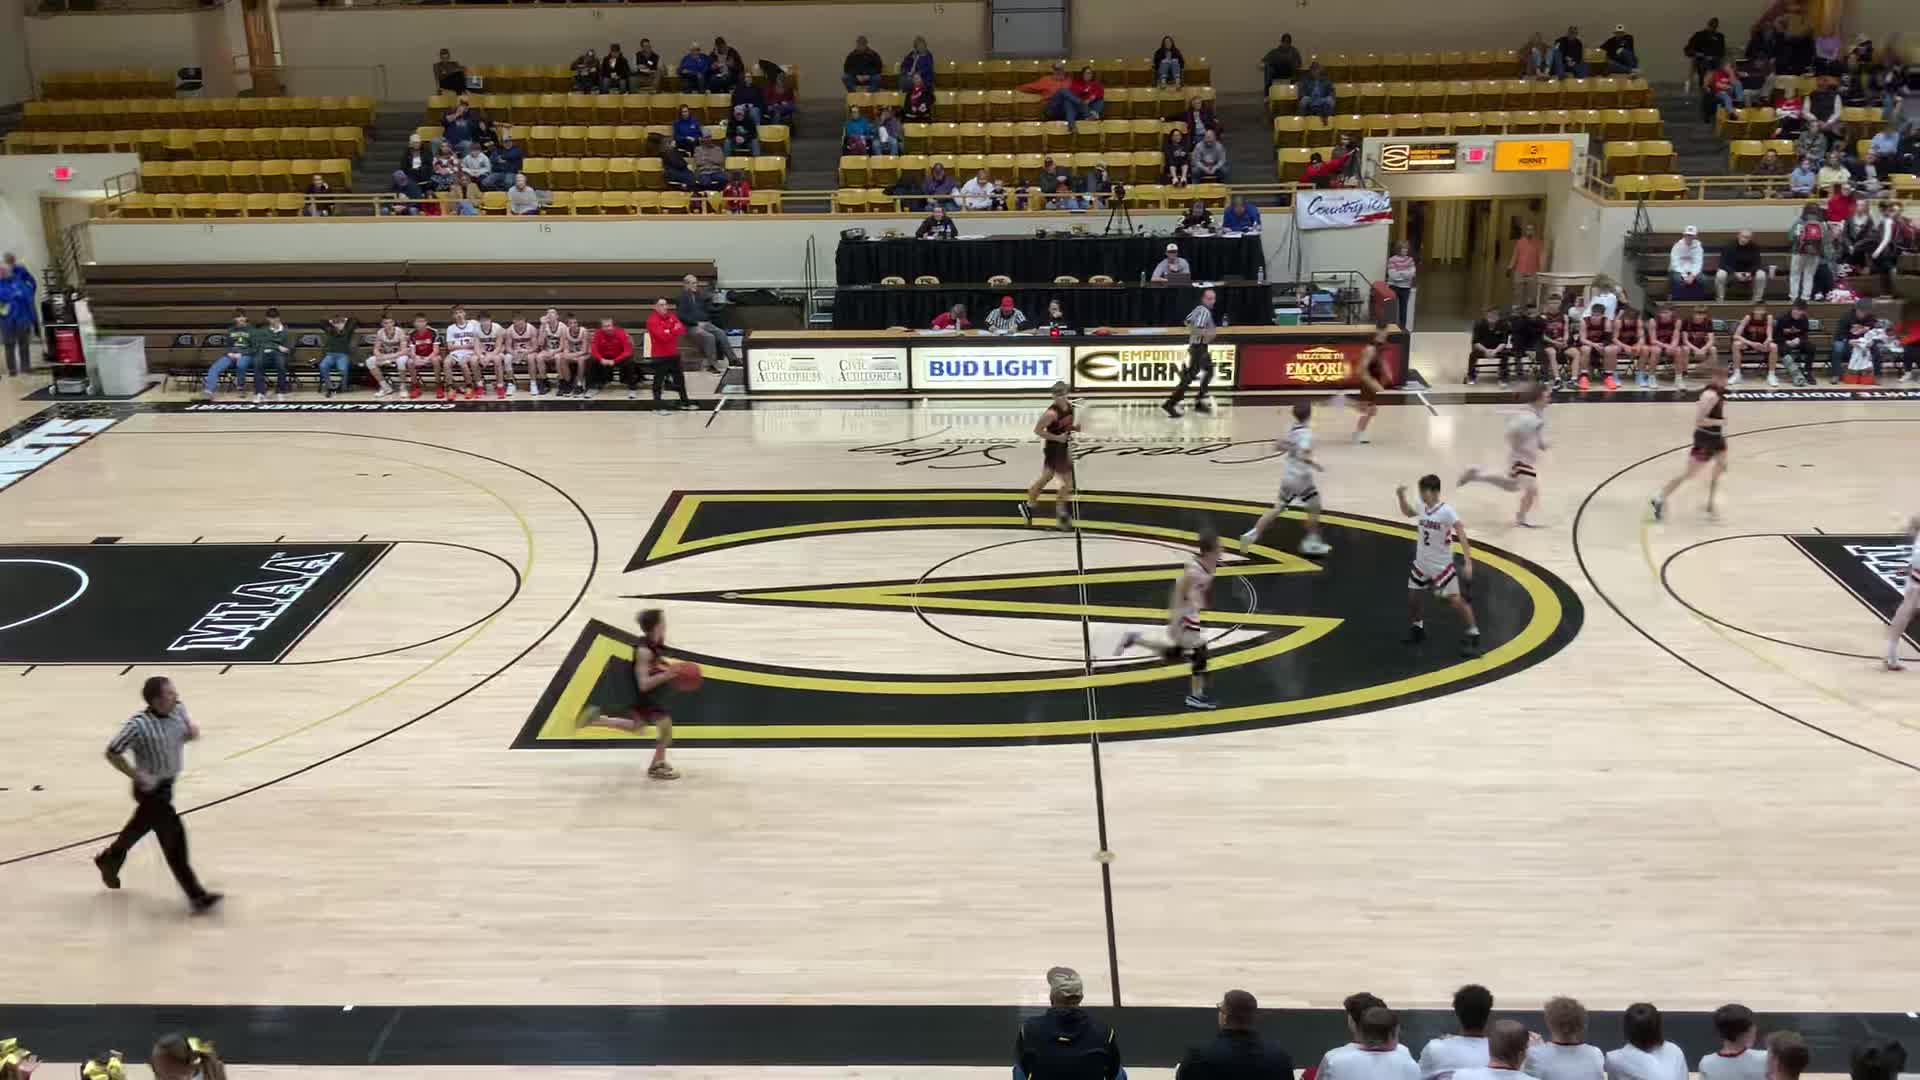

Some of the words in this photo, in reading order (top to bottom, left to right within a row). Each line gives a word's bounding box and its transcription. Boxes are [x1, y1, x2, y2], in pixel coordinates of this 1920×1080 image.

[929, 360, 979, 376] BUD
[983, 360, 1052, 376] LIGHT
[1723, 391, 1852, 399] AUDITORIUM
[167, 551, 345, 651] MIAA
